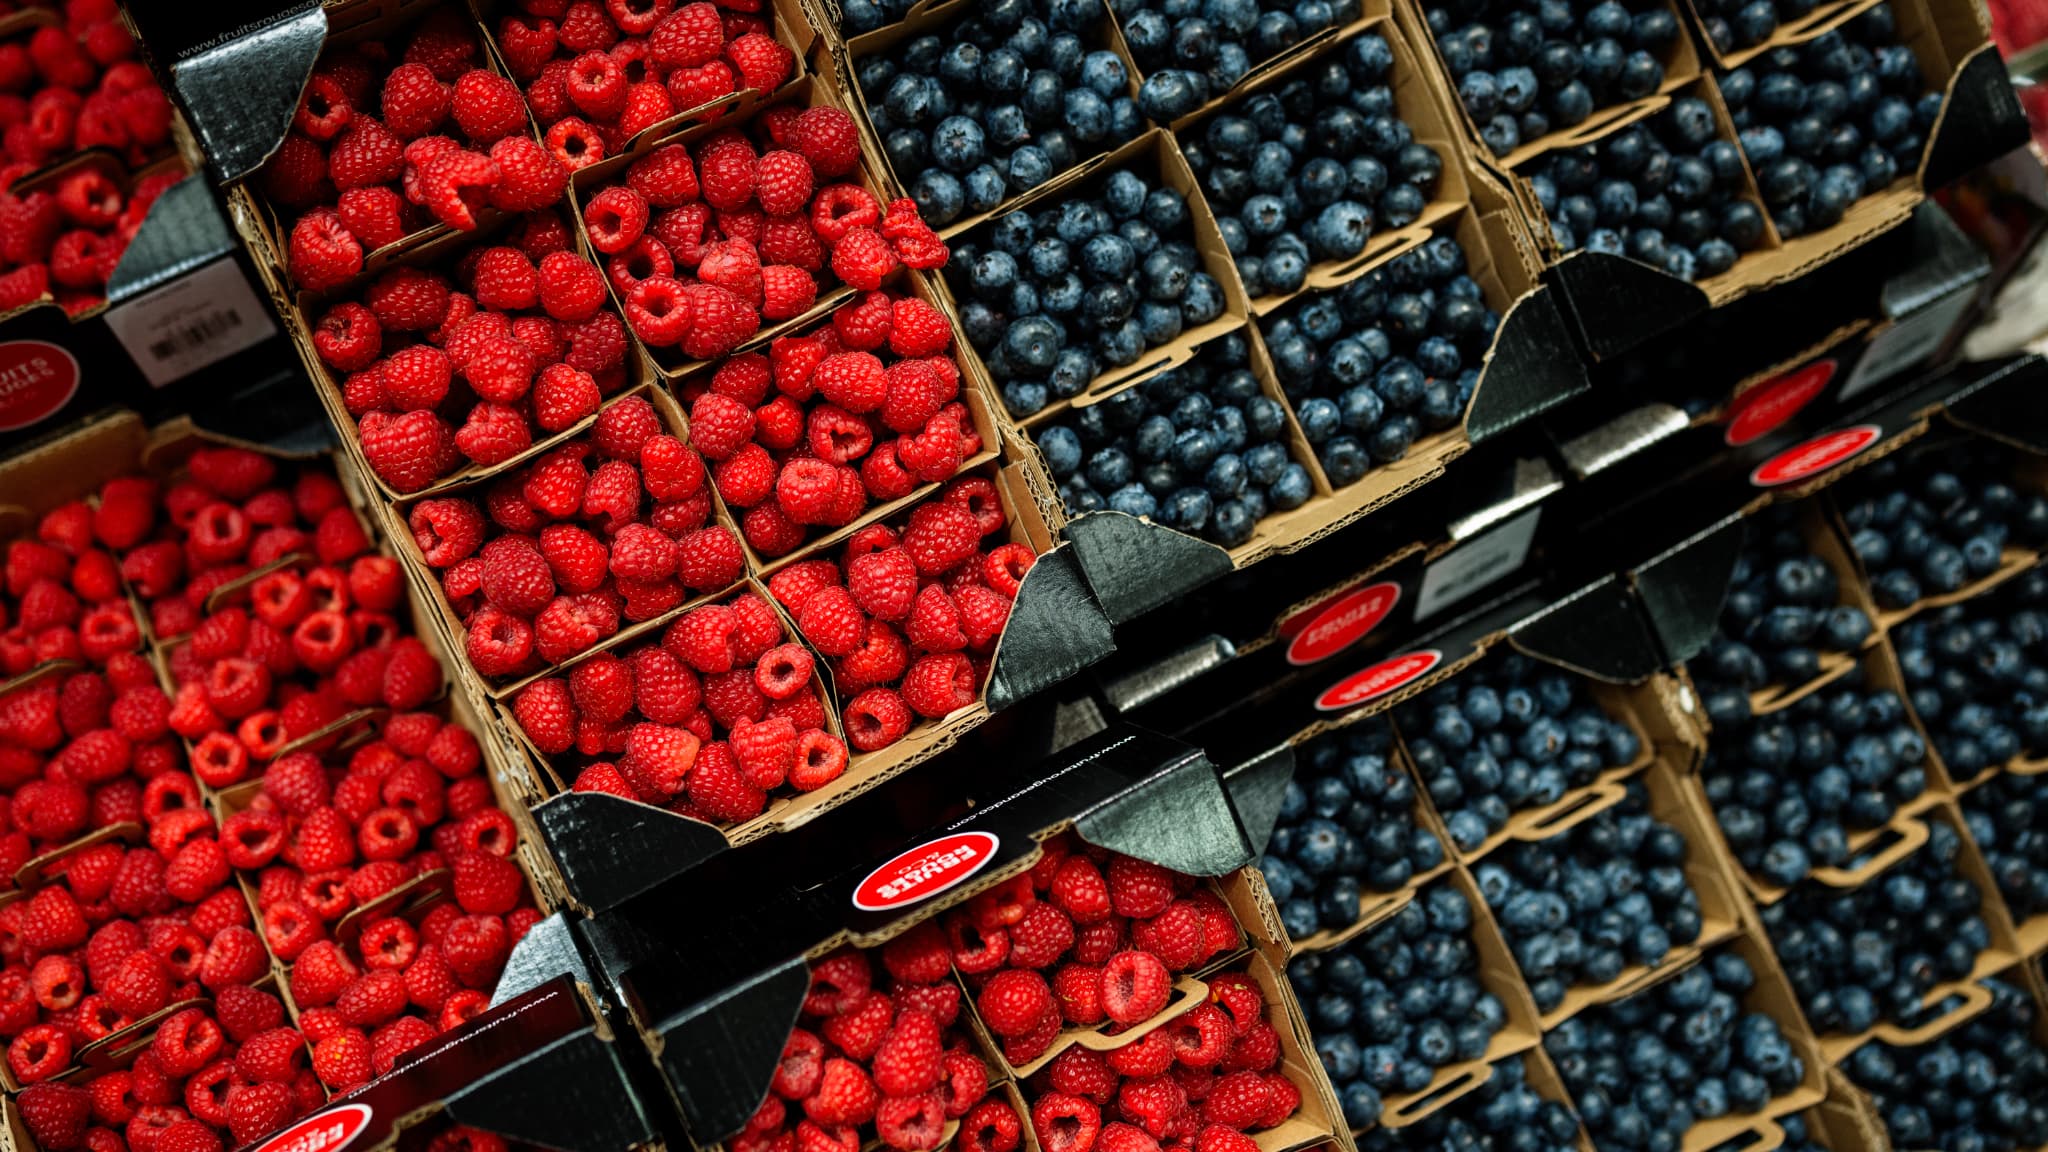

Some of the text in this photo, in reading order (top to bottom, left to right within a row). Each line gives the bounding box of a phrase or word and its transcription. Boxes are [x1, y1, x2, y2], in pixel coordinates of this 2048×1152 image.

[946, 735, 1137, 831] www.fruitsrougesandco.com
[876, 844, 970, 895] ROUGES
[879, 849, 978, 900] FRUITS
